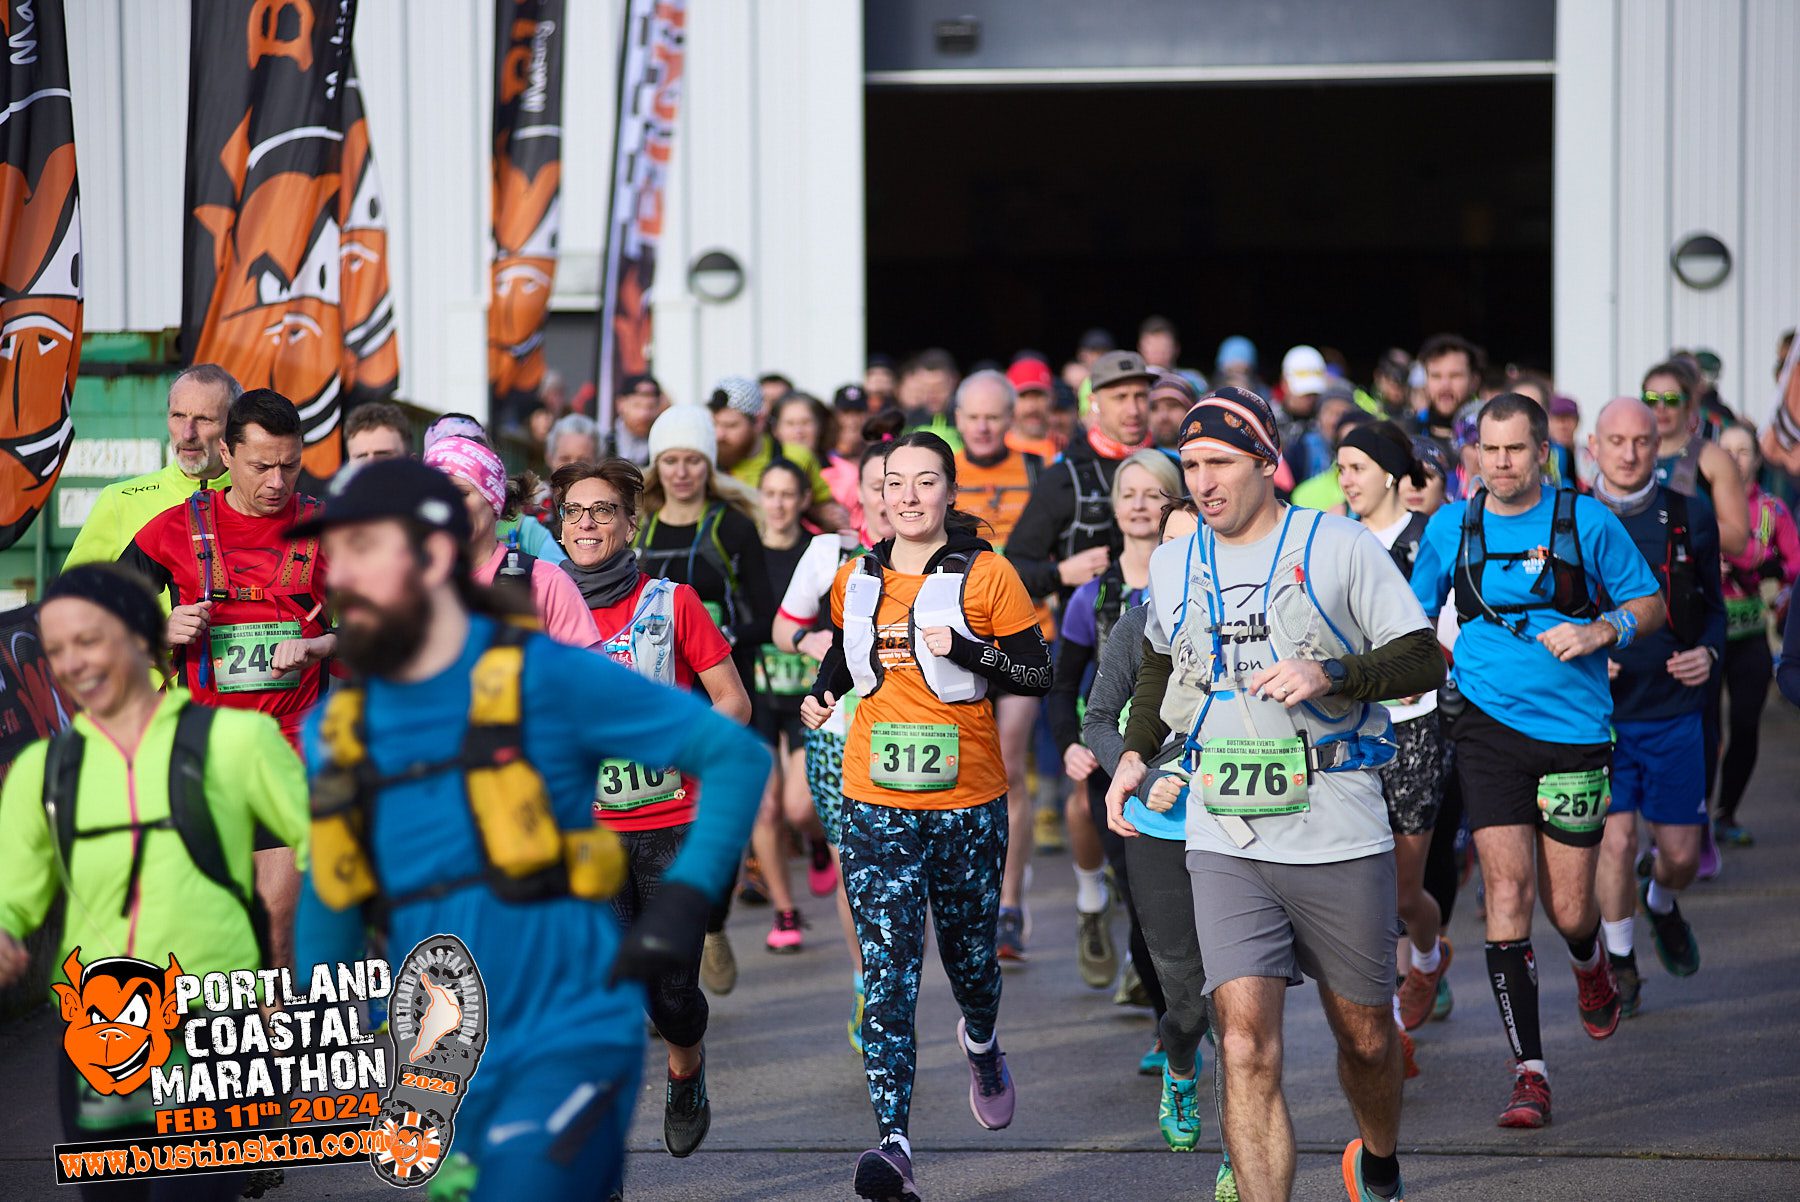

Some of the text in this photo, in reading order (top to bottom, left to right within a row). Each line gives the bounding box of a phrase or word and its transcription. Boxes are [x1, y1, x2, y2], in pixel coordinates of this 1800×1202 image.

[1257, 740, 1276, 748] EVENTS
[1261, 747, 1290, 755] MARATHON
[883, 743, 941, 774] 312
[1219, 762, 1288, 796] 276
[1552, 790, 1602, 817] 257
